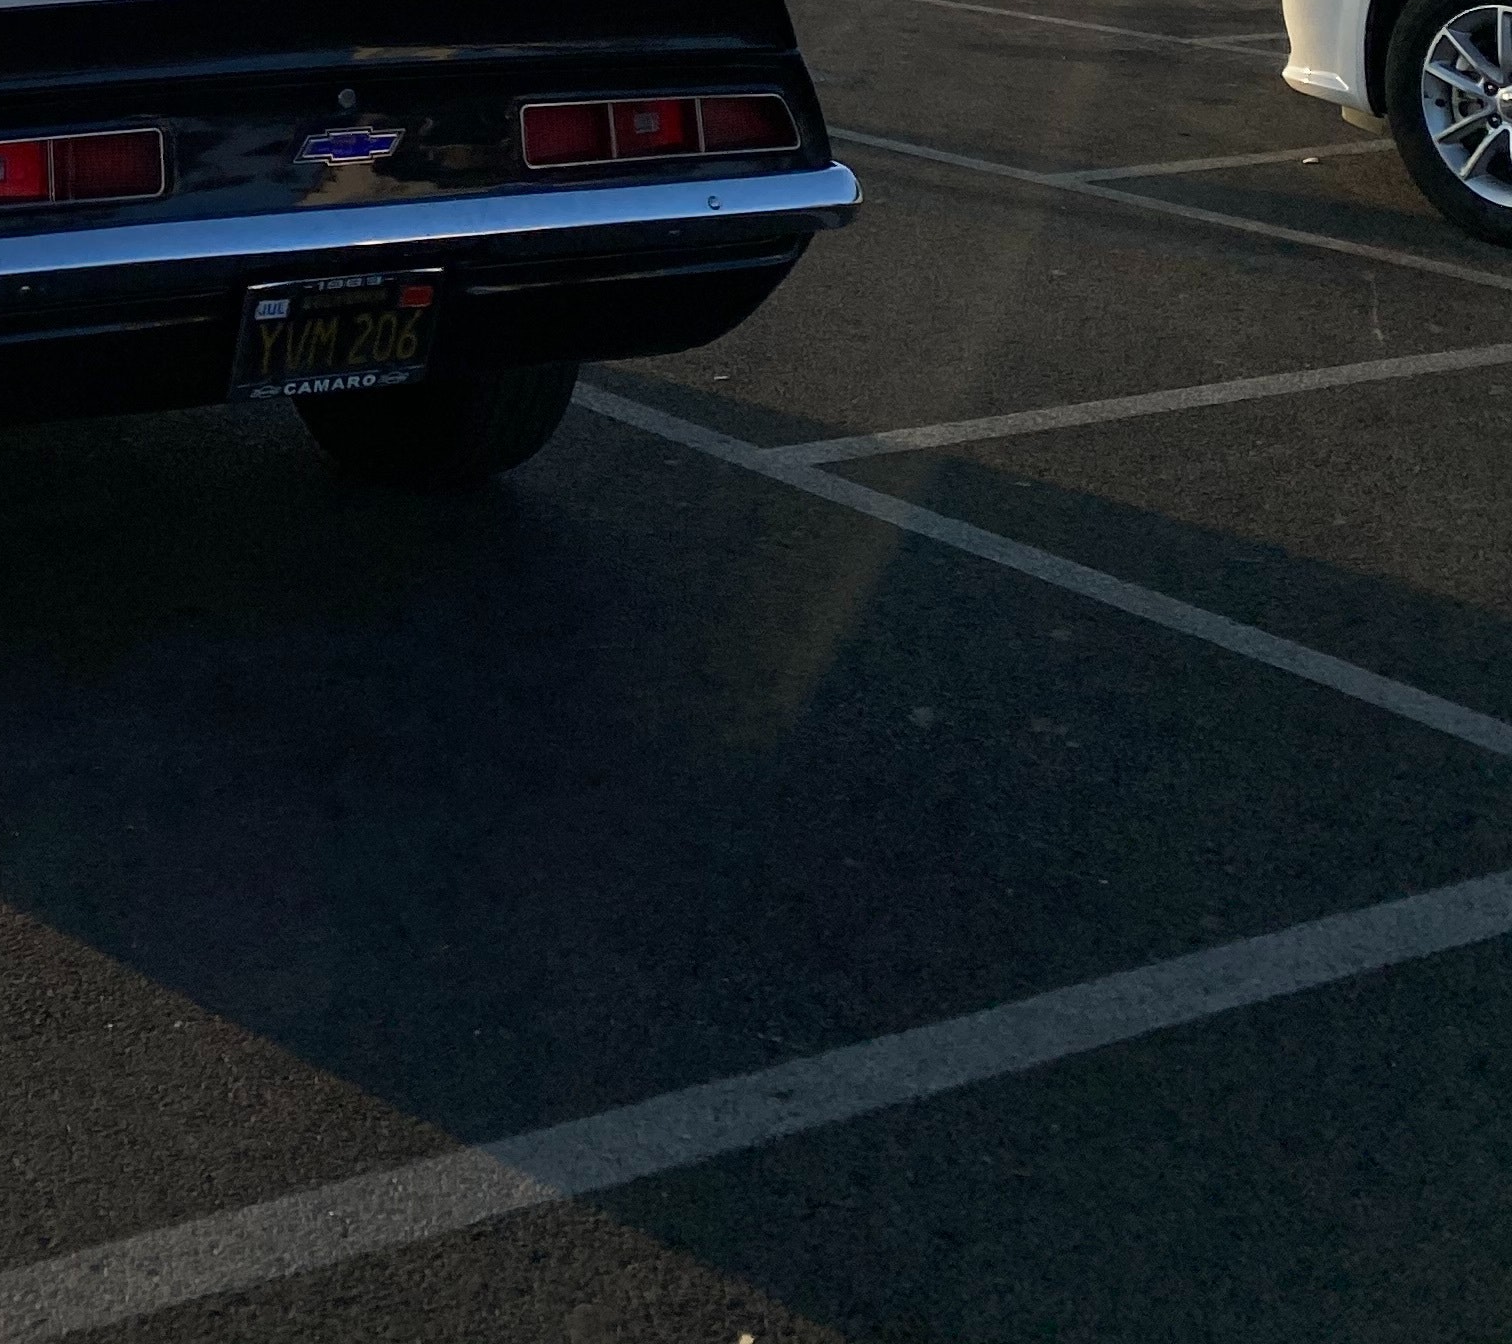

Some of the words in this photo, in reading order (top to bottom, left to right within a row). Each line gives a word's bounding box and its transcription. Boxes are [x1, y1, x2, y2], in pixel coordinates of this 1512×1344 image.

[258, 303, 285, 316] JUL
[348, 310, 422, 364] 206
[283, 374, 377, 396] CAMARO
